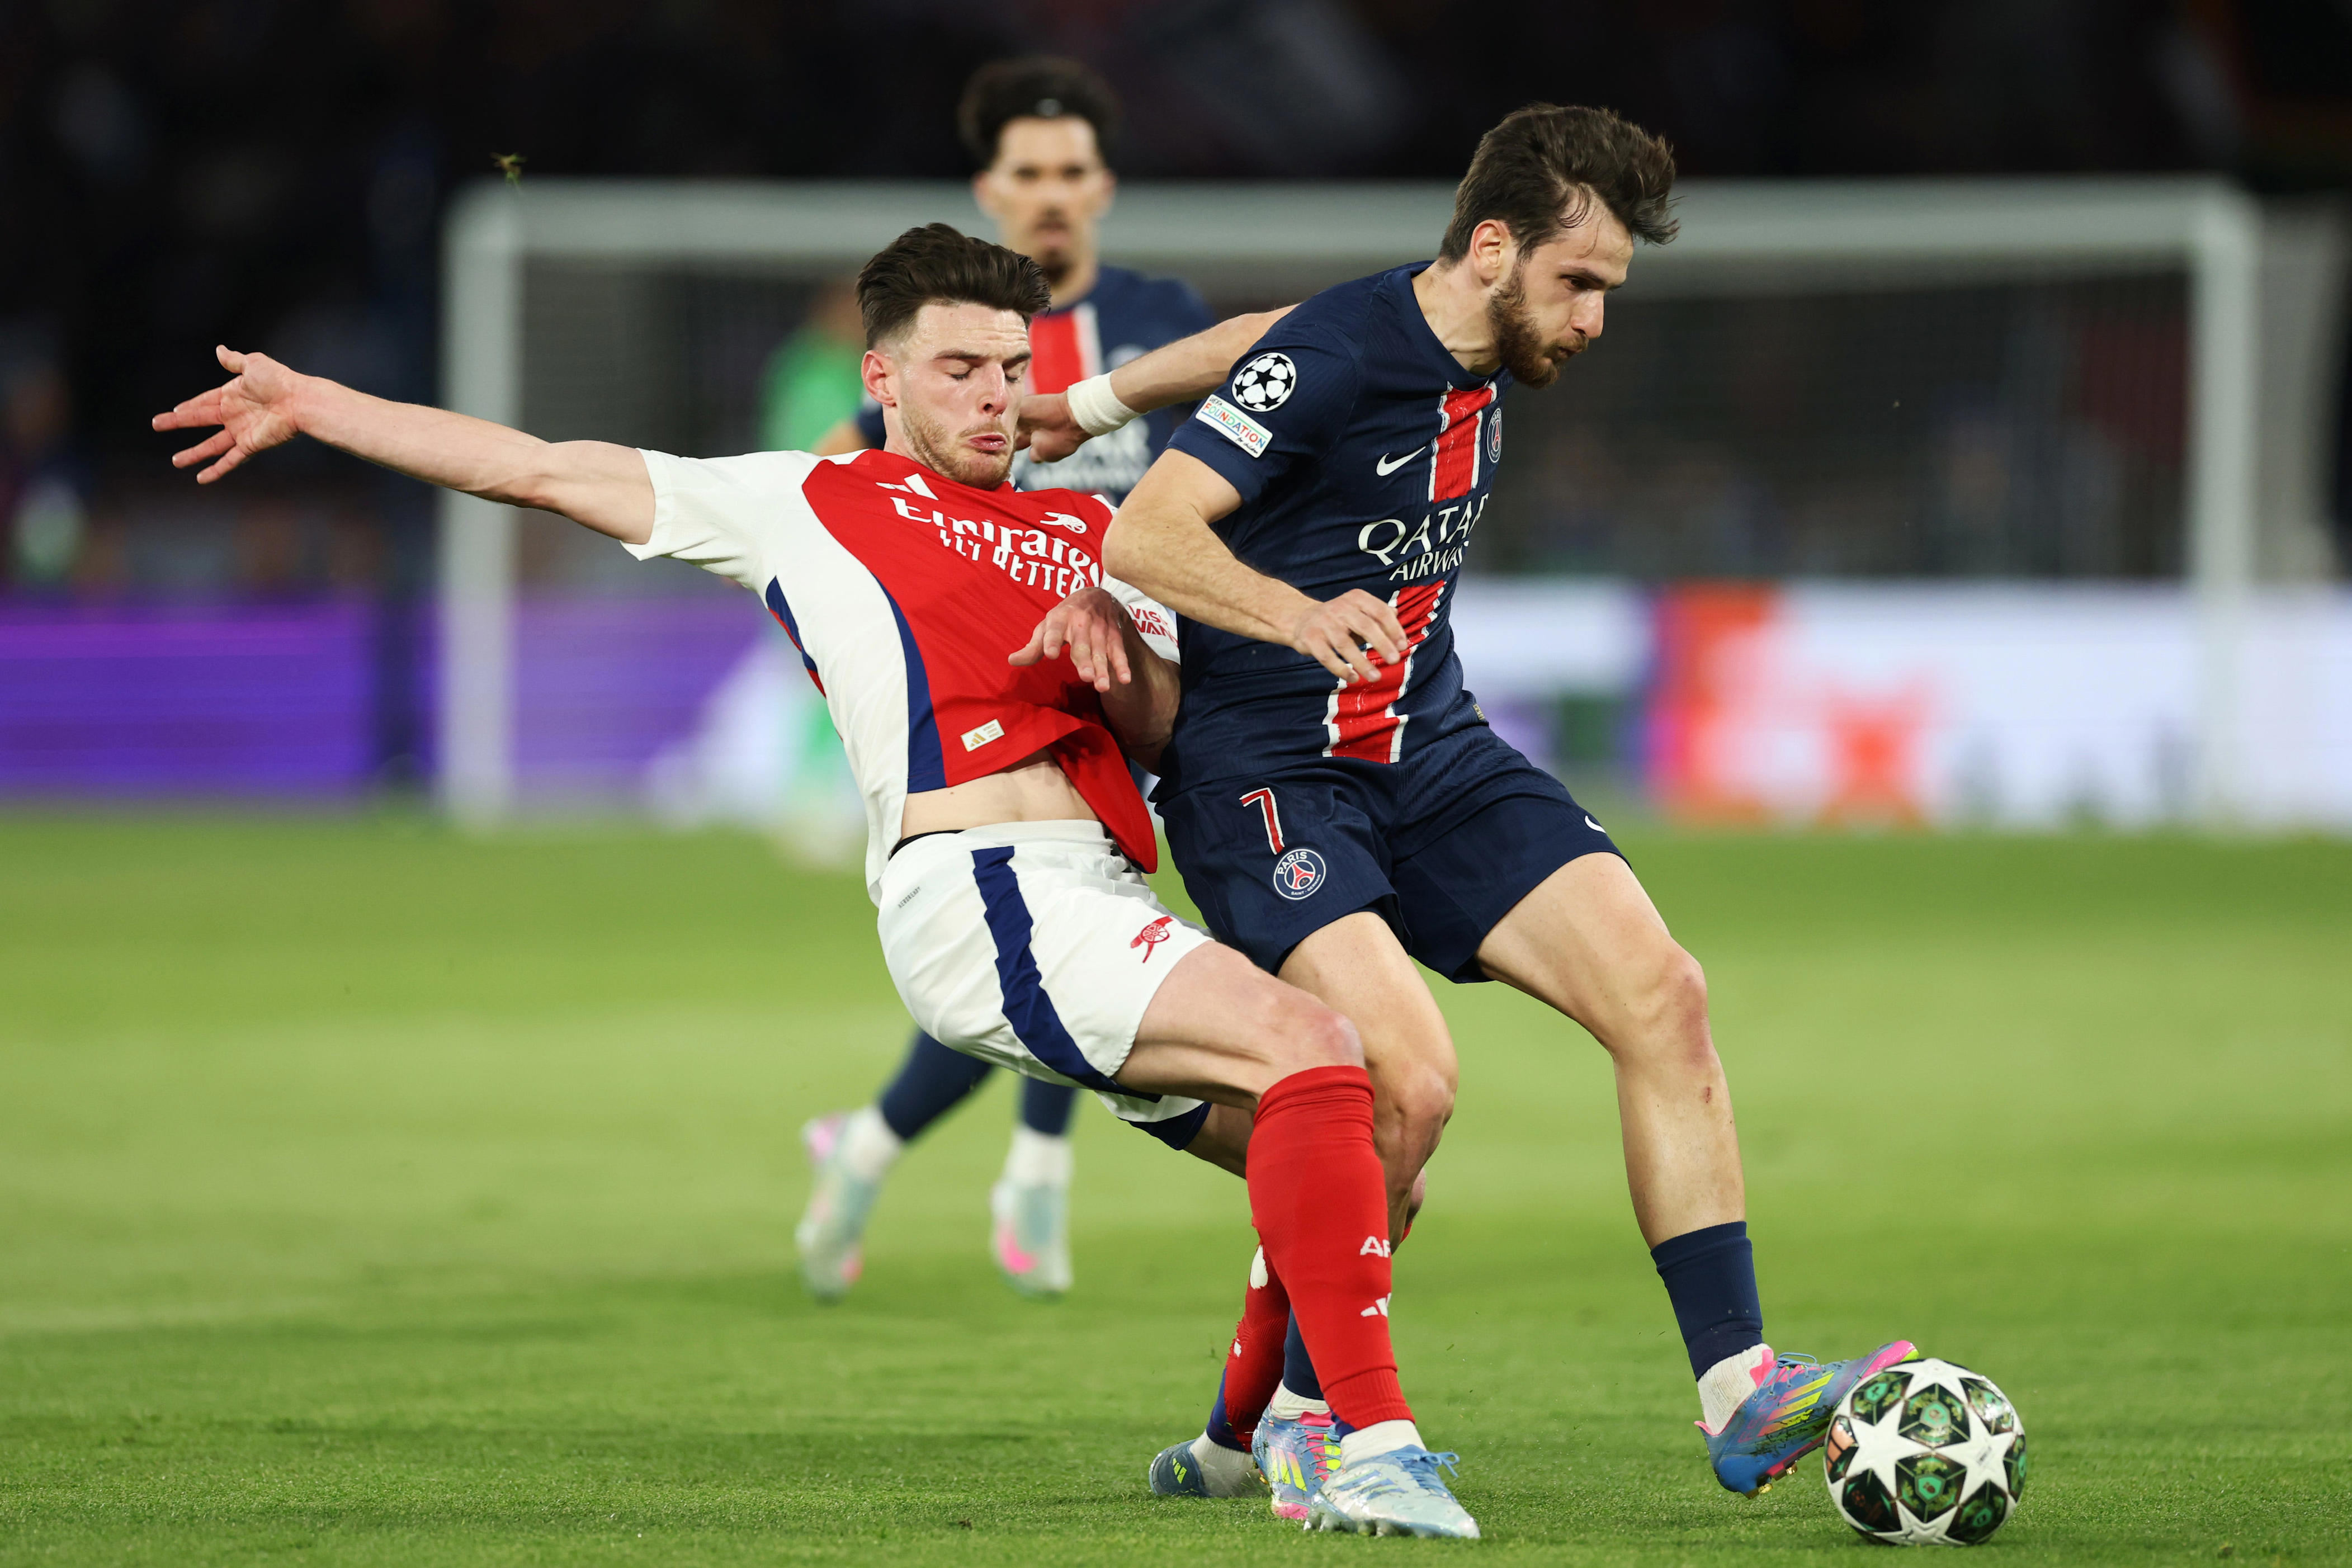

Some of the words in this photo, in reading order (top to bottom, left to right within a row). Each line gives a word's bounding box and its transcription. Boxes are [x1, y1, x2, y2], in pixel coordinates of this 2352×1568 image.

[1389, 540, 1470, 581] AIRWA
[1239, 787, 1285, 855] 7
[1277, 851, 1307, 874] PARIS
